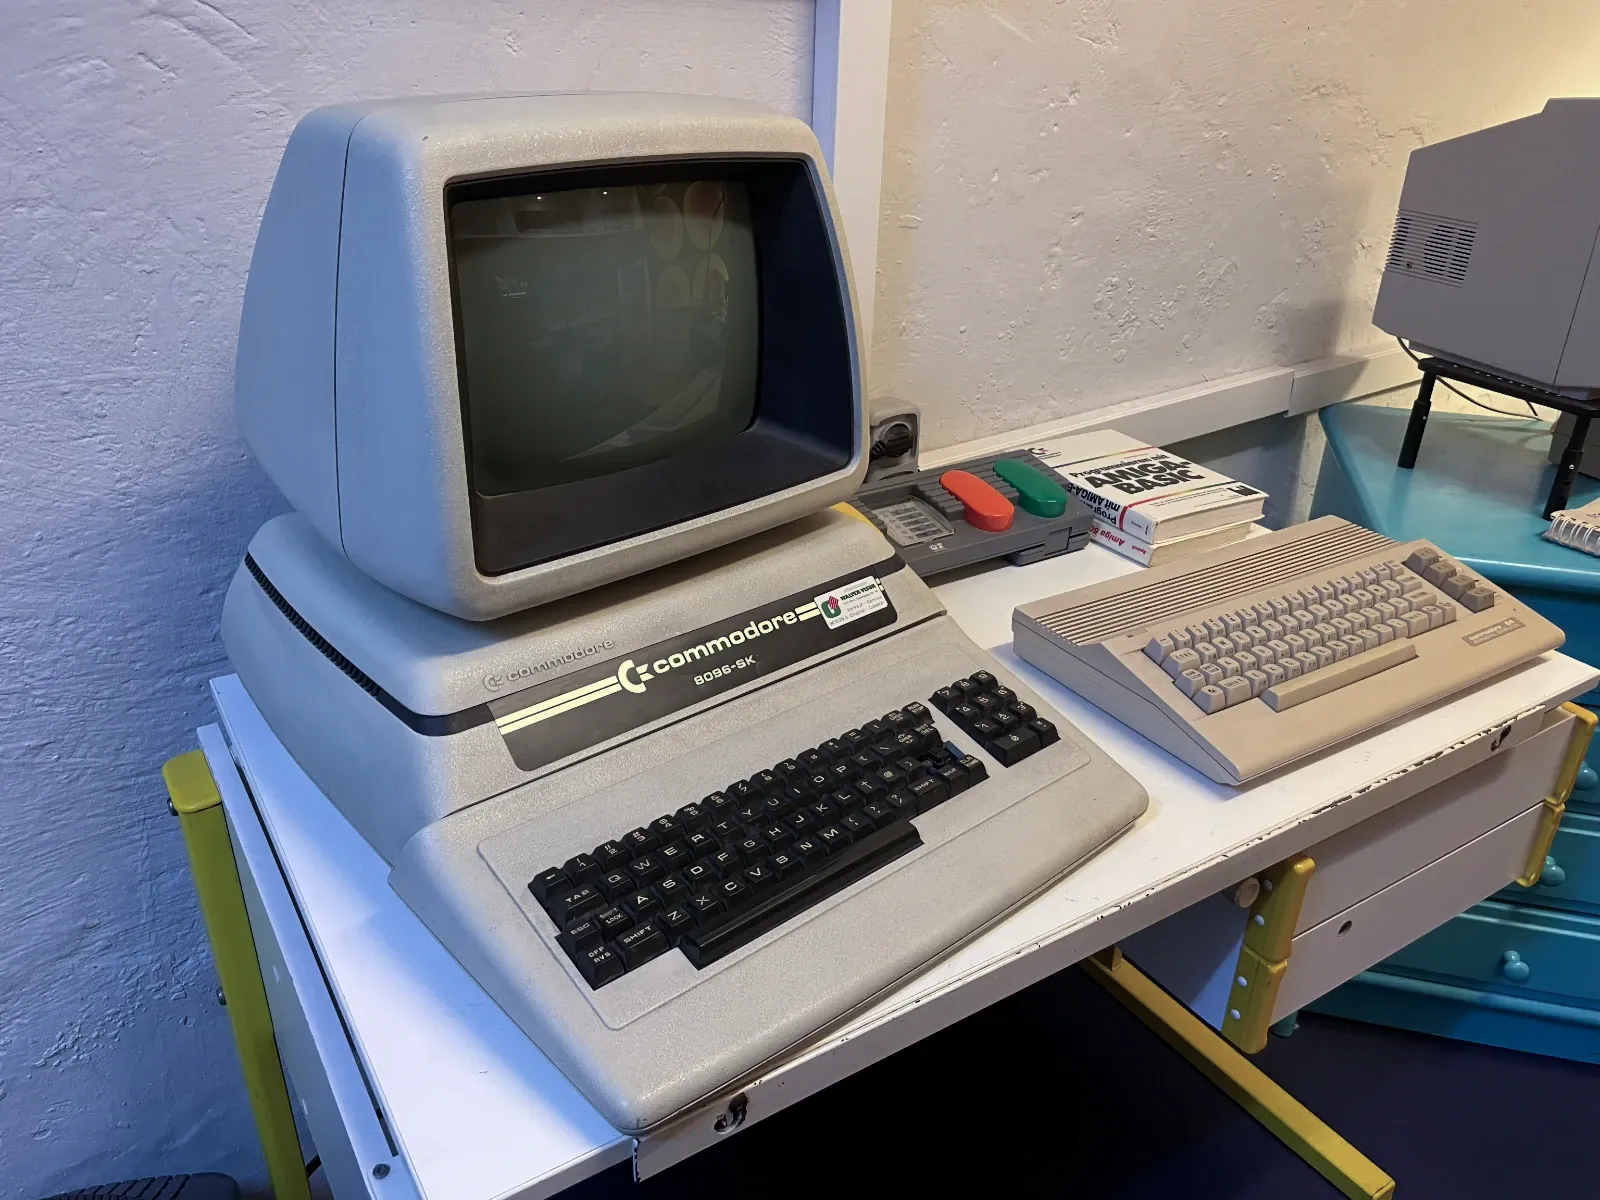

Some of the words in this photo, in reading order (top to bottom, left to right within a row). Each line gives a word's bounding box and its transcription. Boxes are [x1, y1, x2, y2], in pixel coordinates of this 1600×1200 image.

[1084, 459, 1193, 488] AMIGA-
[1112, 469, 1206, 494] BASIC
[1104, 499, 1121, 512] mit
[1100, 529, 1126, 546] Amiga
[653, 608, 798, 674] commodore
[506, 639, 616, 681] commodore
[693, 654, 757, 687] 8096-SK
[914, 778, 934, 791] SHIFT
[816, 804, 829, 812] K
[796, 815, 805, 823] J
[717, 821, 728, 829] T
[769, 827, 782, 836] H
[823, 828, 839, 839] M
[691, 833, 705, 843] R
[744, 840, 756, 848] G
[800, 841, 813, 851] N
[664, 846, 678, 856] E
[717, 852, 729, 861] F
[634, 859, 650, 871] W
[776, 855, 789, 864] B
[690, 866, 703, 875] D
[750, 867, 762, 877] V
[608, 874, 622, 883] Q
[662, 879, 676, 889] S
[724, 881, 737, 891] C
[565, 889, 590, 904] TAB
[637, 895, 649, 905] A
[695, 895, 710, 905] X
[600, 907, 619, 920] SHIFT
[606, 913, 624, 924] LOCK
[667, 910, 682, 921] Z
[570, 922, 591, 935] ESC
[623, 925, 652, 944] SHIFT
[588, 946, 605, 958] OFF
[594, 951, 611, 964] RVS
